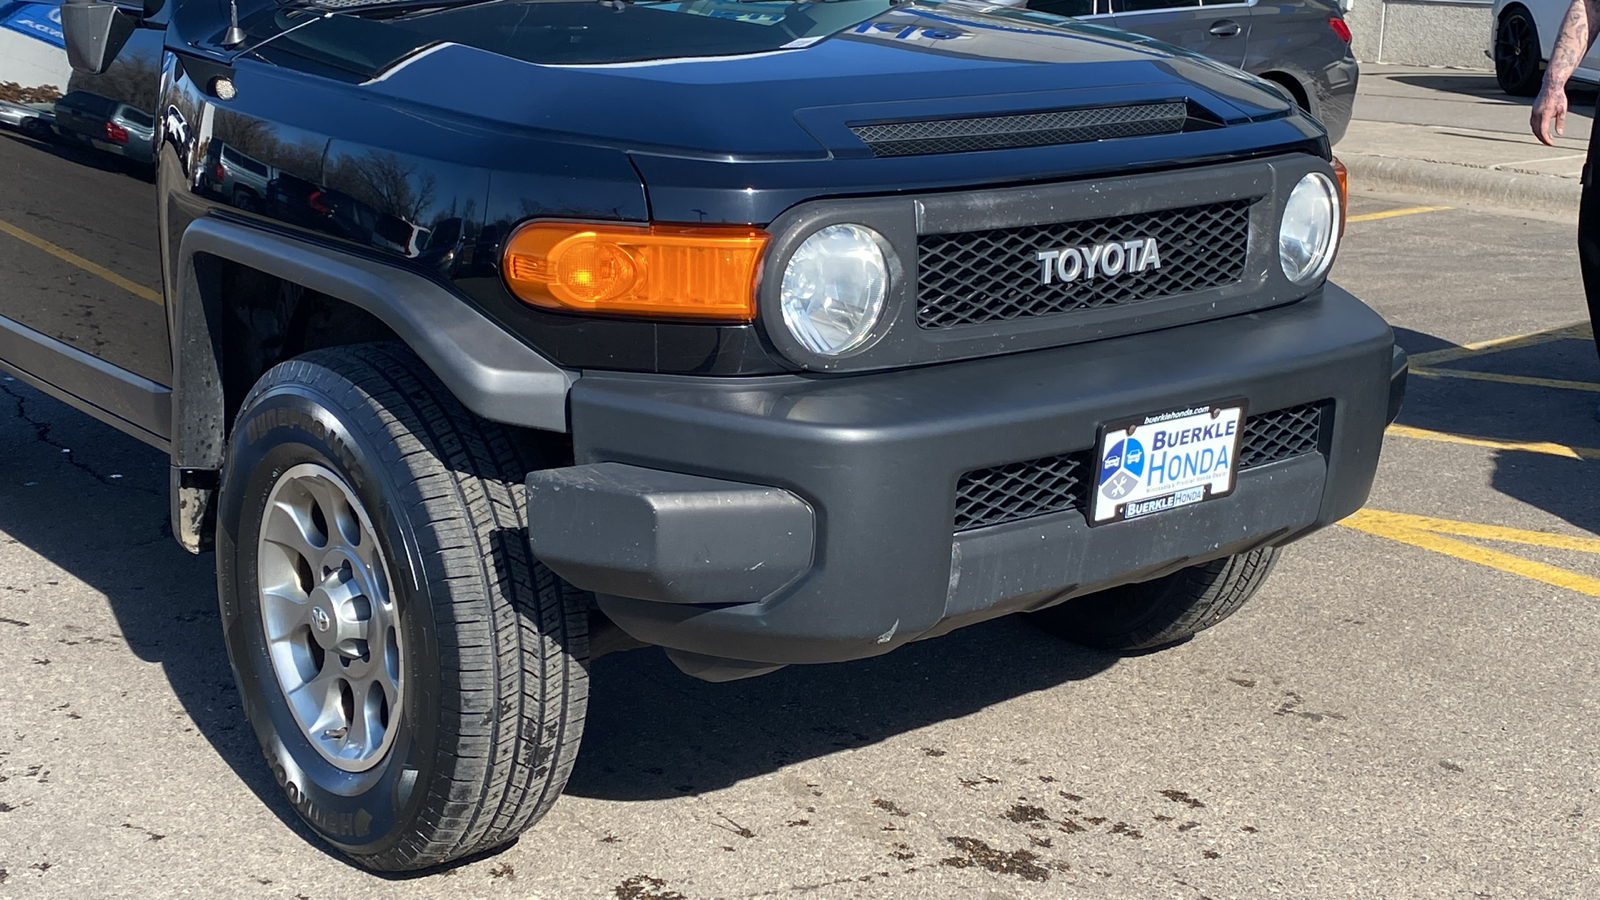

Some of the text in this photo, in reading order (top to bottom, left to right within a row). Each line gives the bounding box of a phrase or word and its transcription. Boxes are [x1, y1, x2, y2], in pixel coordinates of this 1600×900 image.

[1036, 237, 1161, 285] TOYOTA
[1144, 405, 1210, 425] buerklehonda.com
[1152, 419, 1236, 451] BUERKLE
[1147, 445, 1229, 487] HONDA
[1126, 490, 1202, 517] BUERKLE HONDA
